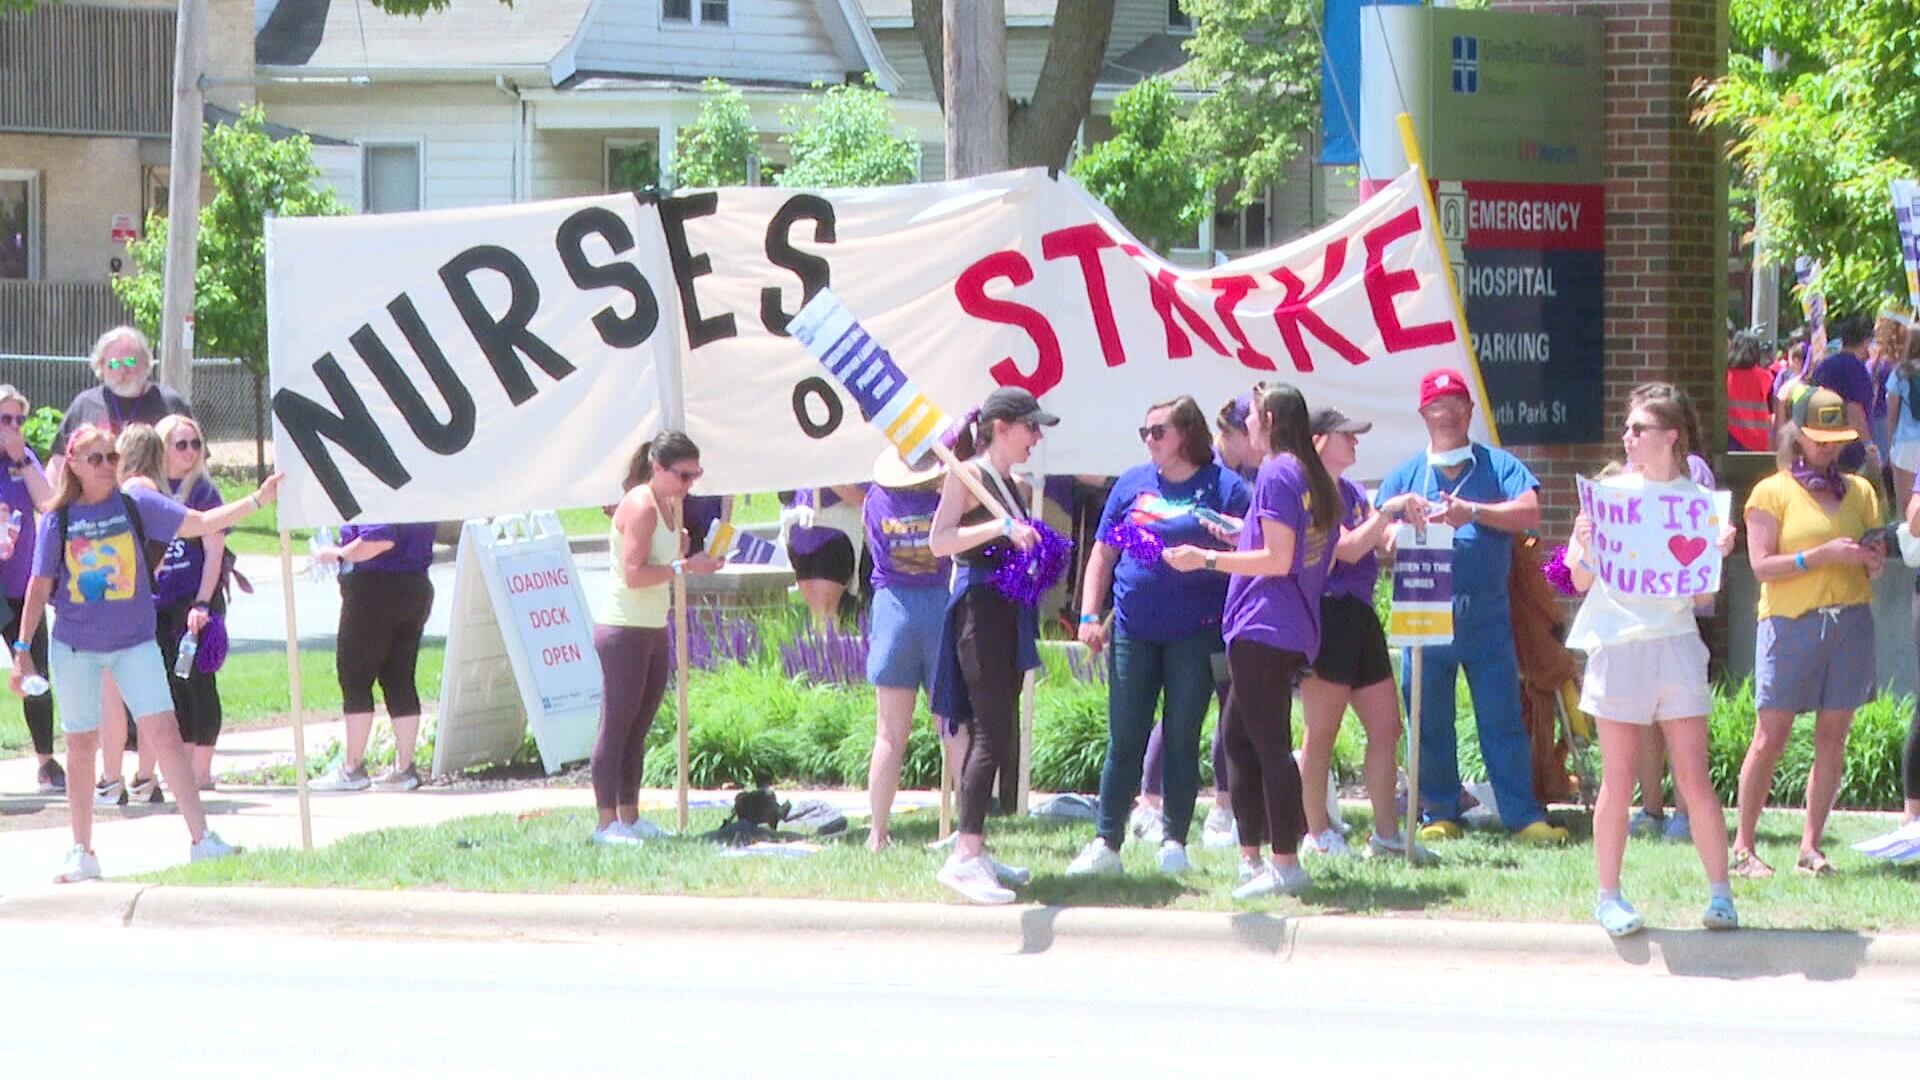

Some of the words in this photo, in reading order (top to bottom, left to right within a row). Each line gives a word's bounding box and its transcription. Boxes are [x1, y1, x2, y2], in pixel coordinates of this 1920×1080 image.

[1468, 199, 1582, 231] EMERGENCY
[1468, 266, 1557, 297] HOSPITAL
[273, 191, 837, 521] NURSES
[1470, 331, 1550, 362] PARKING
[1518, 401, 1548, 424] Park
[1551, 400, 1567, 424] St
[1658, 494, 1709, 530] If
[505, 567, 570, 594] LOADING
[528, 606, 570, 629] DOCK
[541, 643, 582, 667] OPEN
